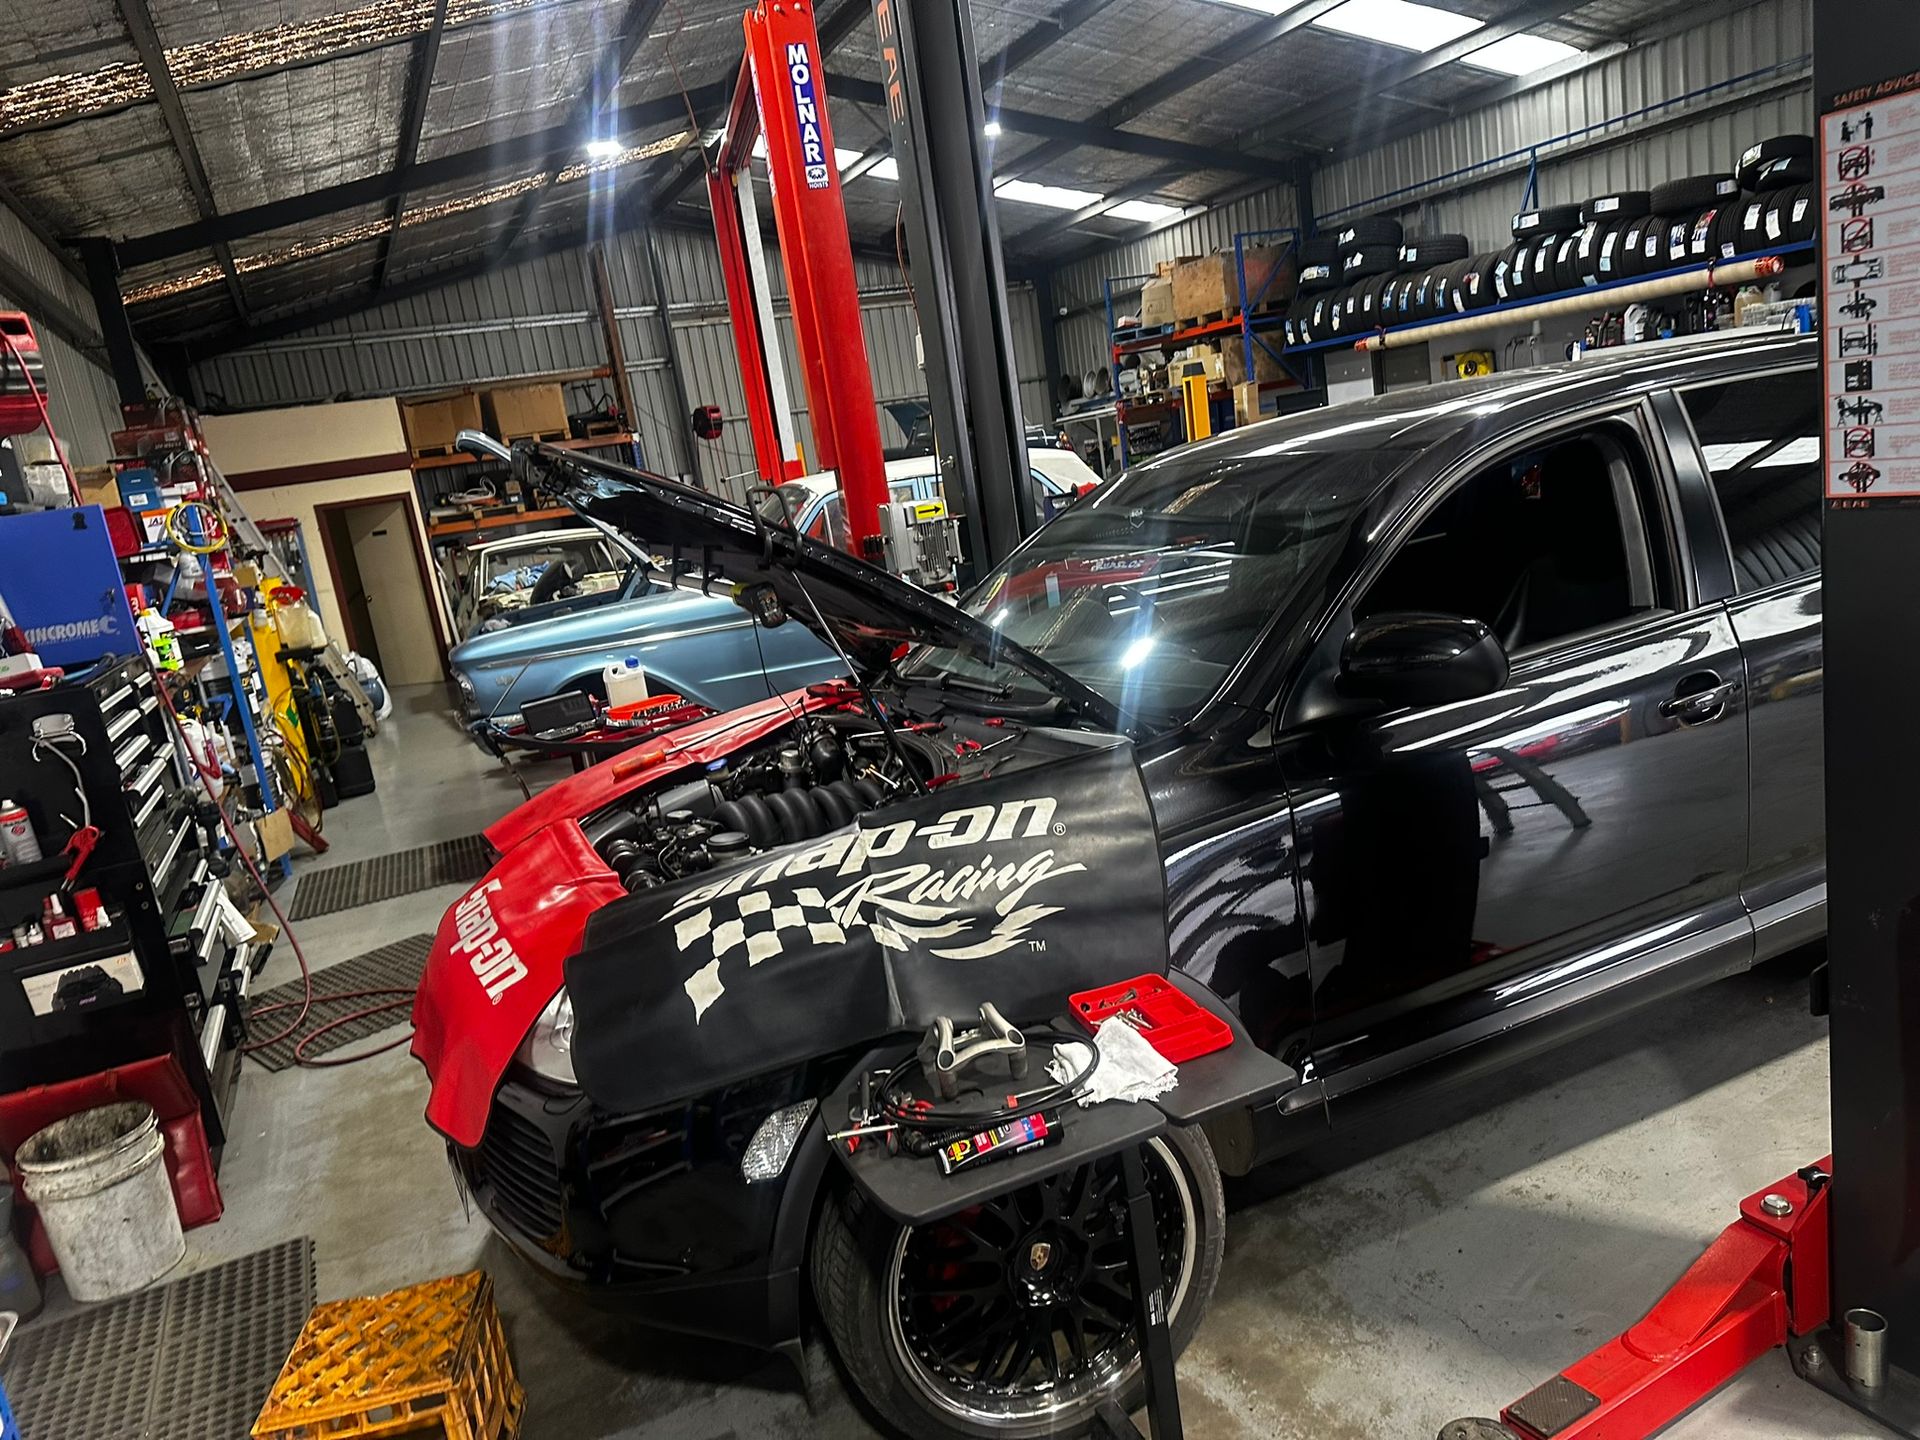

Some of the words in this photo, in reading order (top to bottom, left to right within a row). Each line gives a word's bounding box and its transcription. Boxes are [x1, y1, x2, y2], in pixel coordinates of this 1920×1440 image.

[788, 43, 822, 163] MOLNAR
[1833, 85, 1872, 107] SAFETY
[825, 850, 1087, 929] Racing
